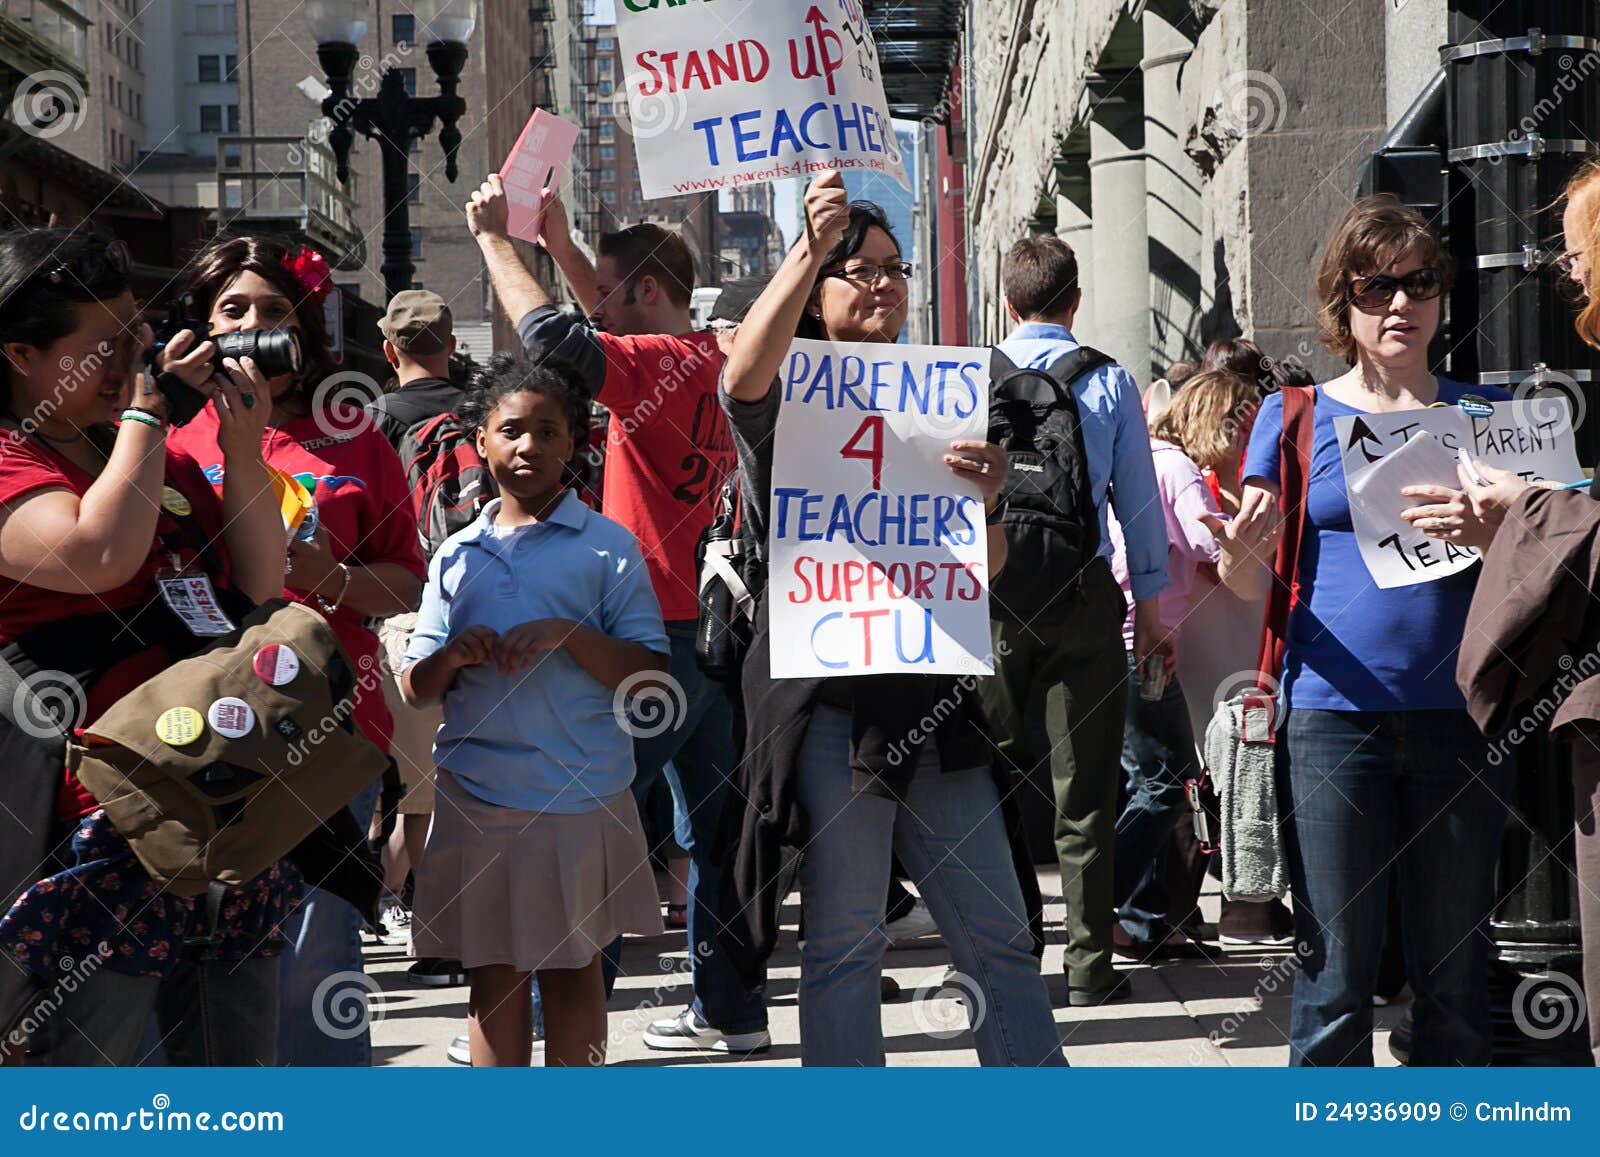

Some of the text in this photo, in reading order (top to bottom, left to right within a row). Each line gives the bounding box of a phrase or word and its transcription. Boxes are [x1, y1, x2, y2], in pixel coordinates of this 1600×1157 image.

[635, 38, 770, 97] STAND
[785, 351, 982, 419] PARENTS
[840, 415, 884, 490] 4
[1390, 416, 1557, 459] TS PARENT
[774, 487, 977, 547] TEACHERS
[788, 556, 983, 604] SUPPORTS
[811, 608, 935, 668] CTU
